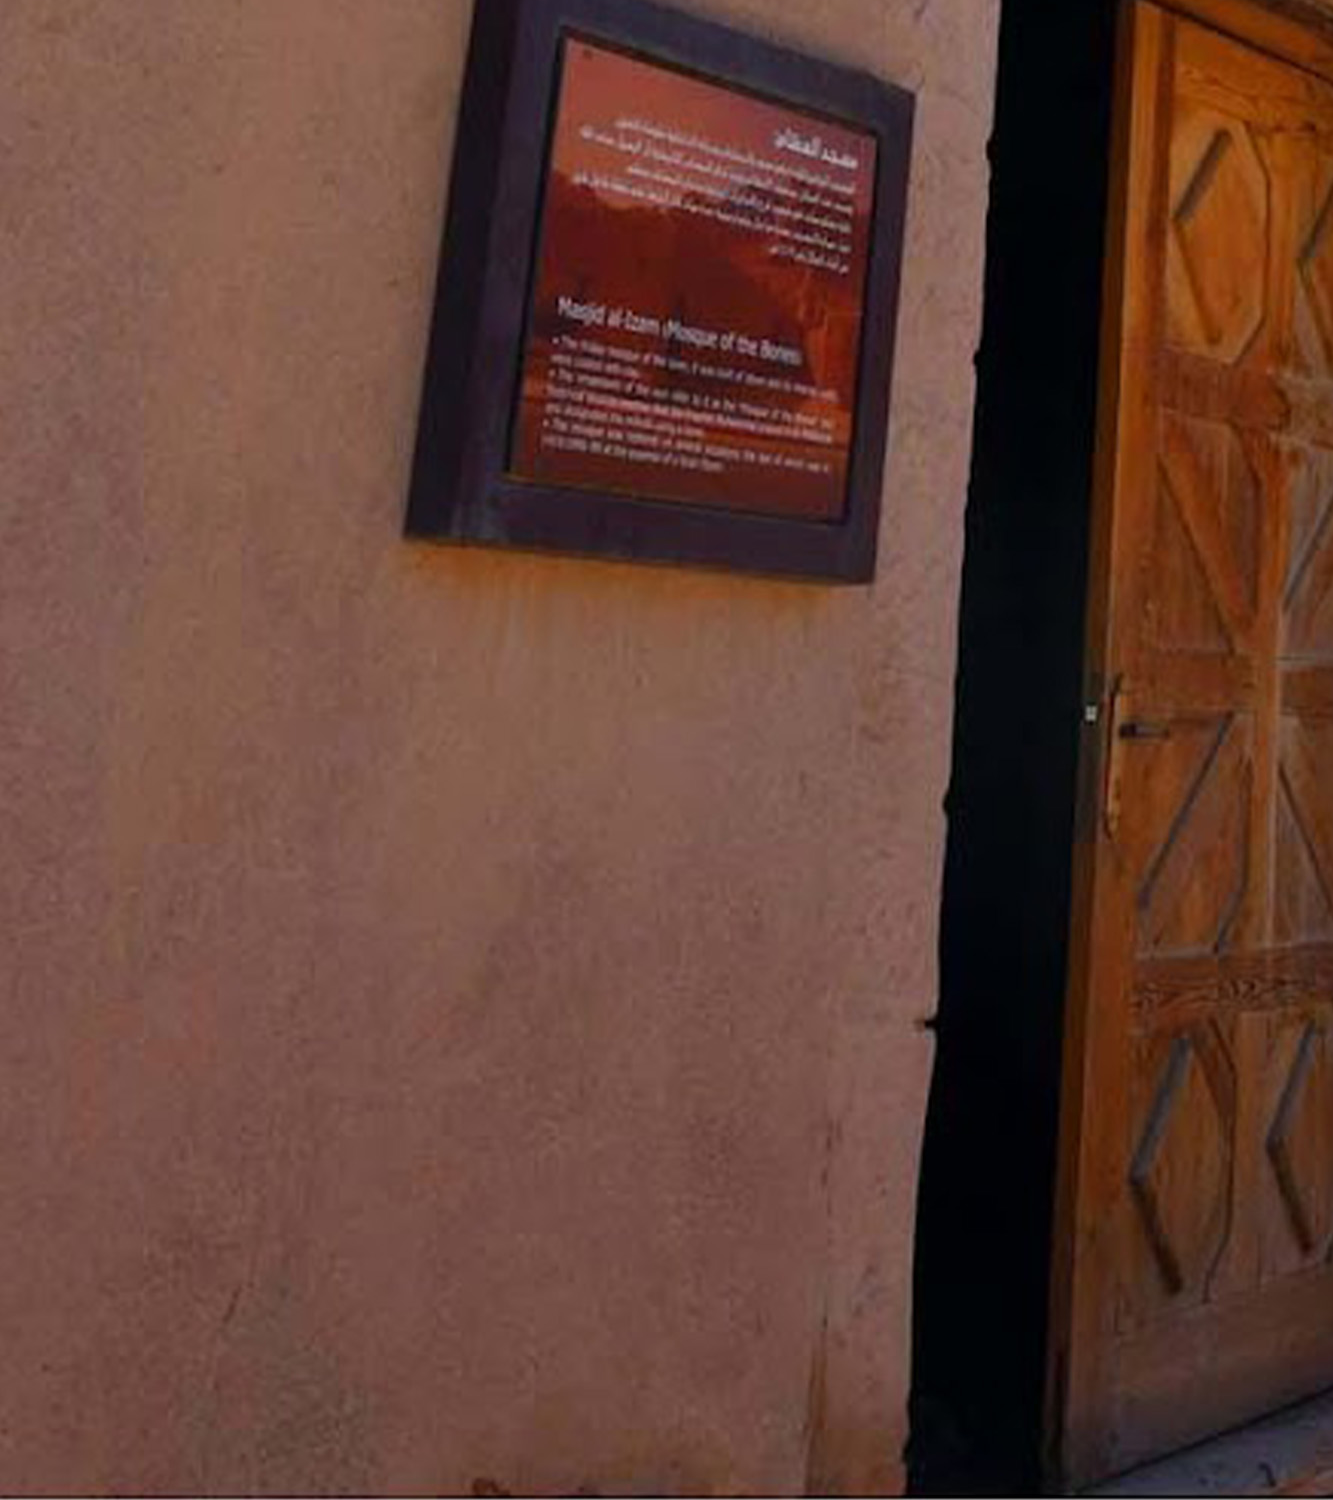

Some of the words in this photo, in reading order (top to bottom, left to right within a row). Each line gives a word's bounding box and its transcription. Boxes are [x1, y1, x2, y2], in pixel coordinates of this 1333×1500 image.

[558, 297, 605, 325] Masjid
[720, 332, 735, 351] of
[737, 336, 758, 356] the
